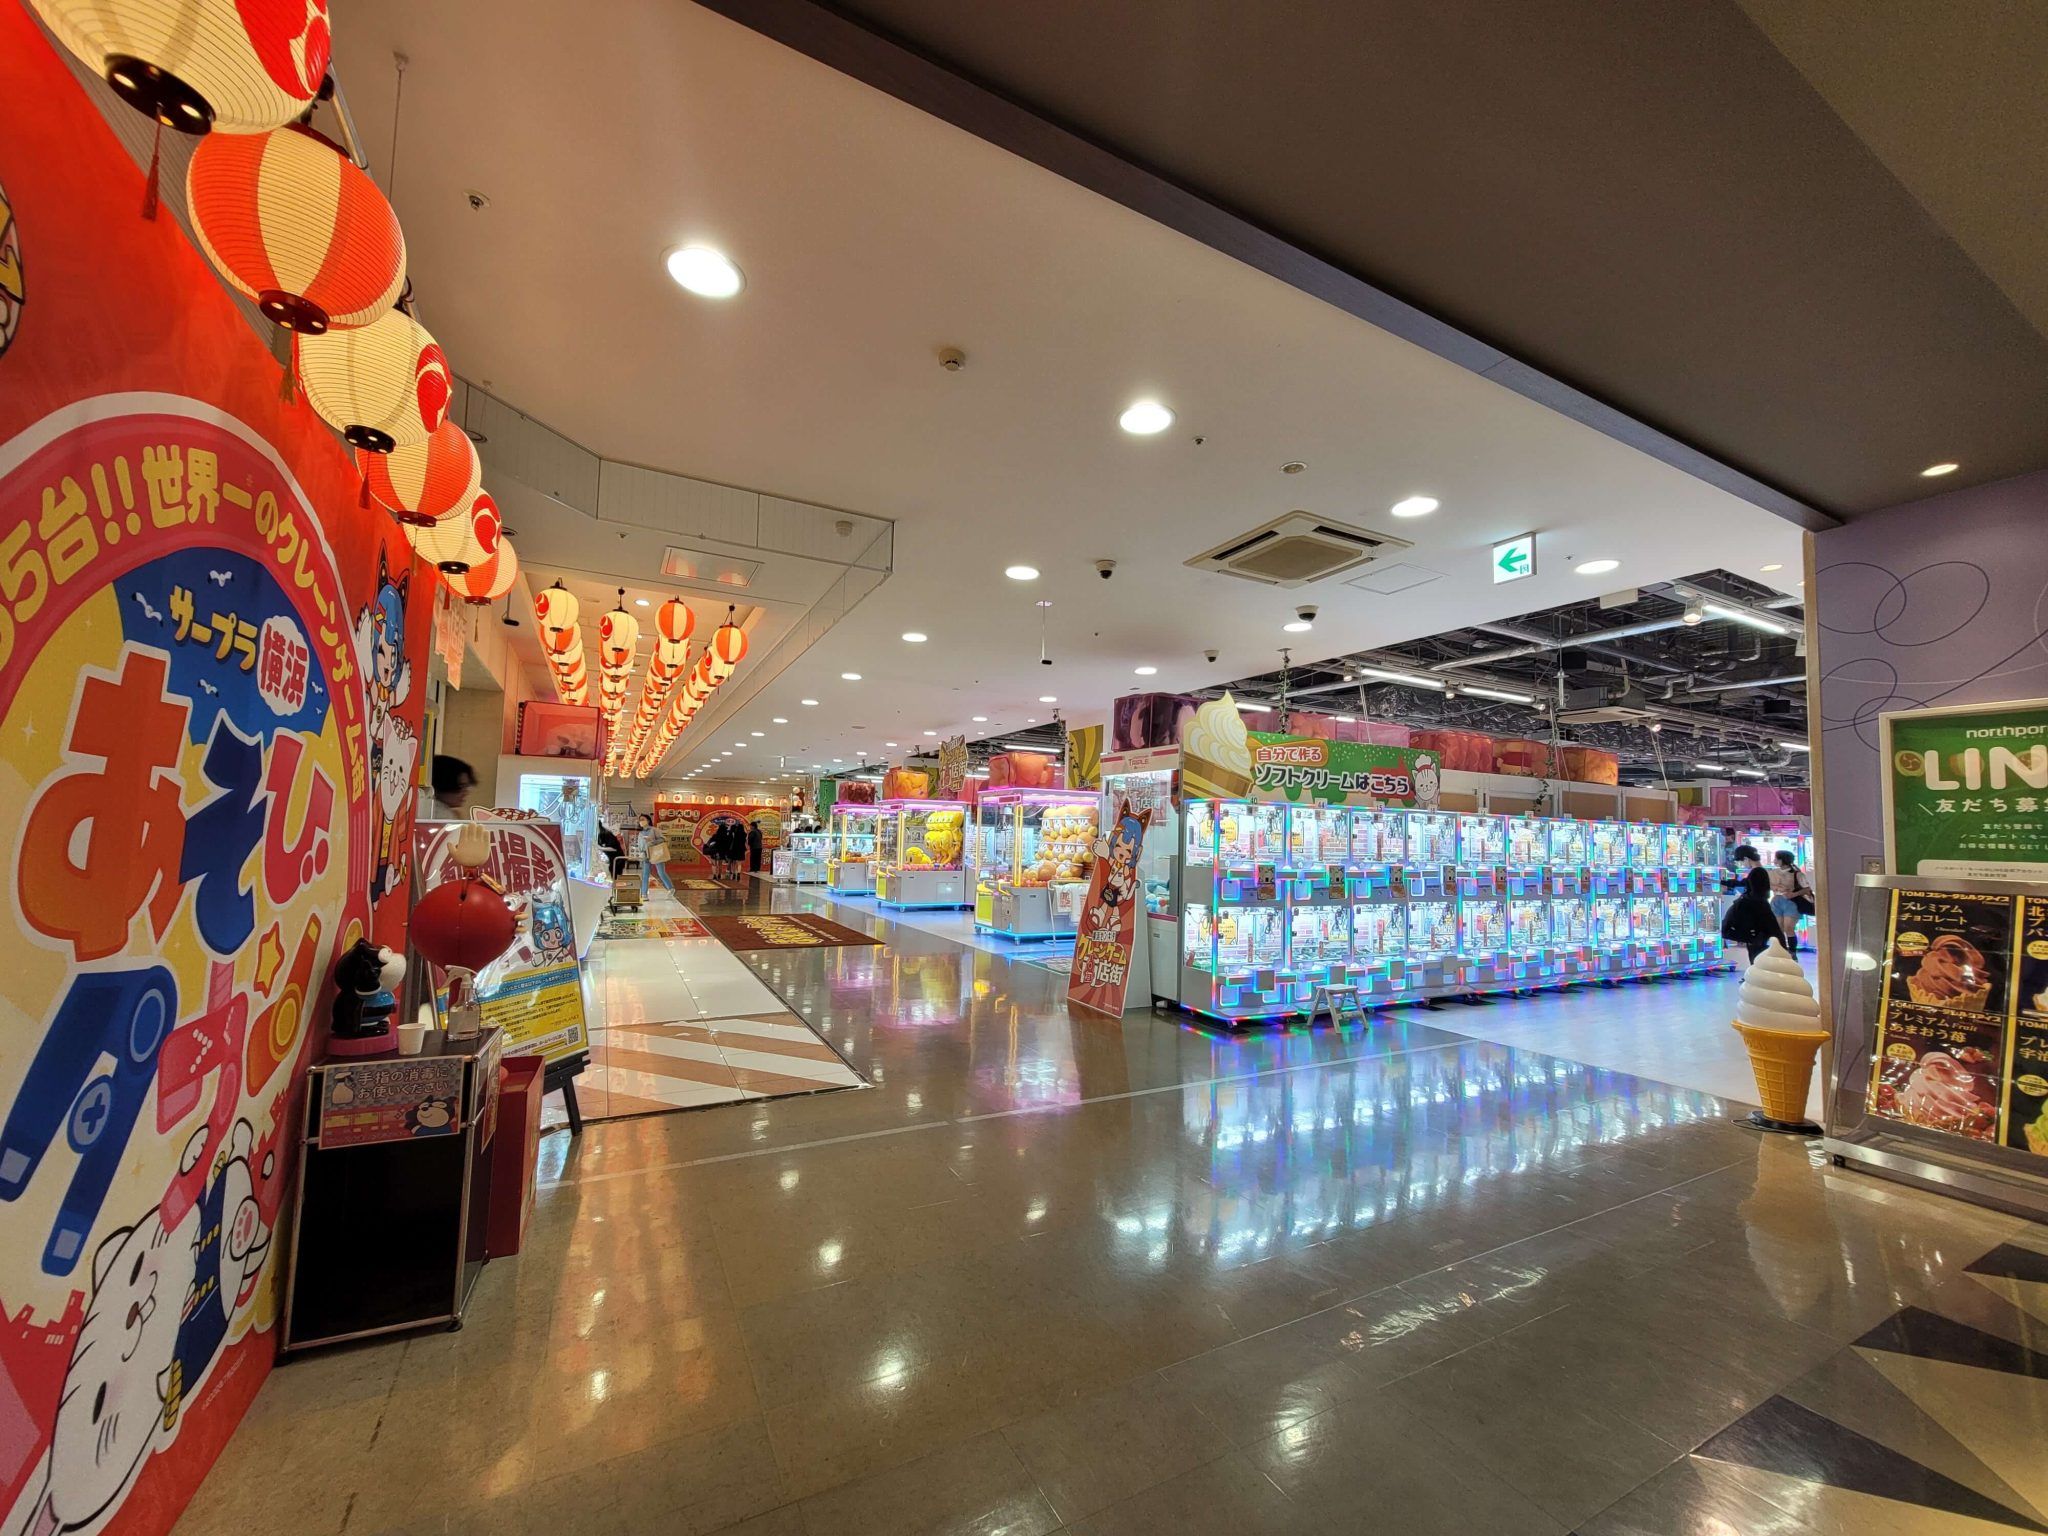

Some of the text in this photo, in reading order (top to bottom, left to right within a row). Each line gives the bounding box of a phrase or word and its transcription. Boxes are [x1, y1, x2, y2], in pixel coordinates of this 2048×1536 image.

[169, 585, 309, 708] サープラ 横浜
[1257, 747, 1323, 762] 自分で作る
[1924, 745, 2048, 790] LIN
[1255, 764, 1410, 794] ソフトクリームはこちら
[1935, 798, 2048, 812] 友だち募
[1901, 901, 1963, 914] プレミアム
[2027, 906, 2048, 917] 北
[1901, 913, 1967, 926] チョコレート
[1078, 934, 1127, 965] クレーンゲーム
[1890, 1009, 1978, 1032] プレミアム Fruit
[1889, 1022, 1968, 1043] あまおう苺
[358, 1066, 448, 1086] 手指の消毒に
[358, 1081, 448, 1099] お使いください
